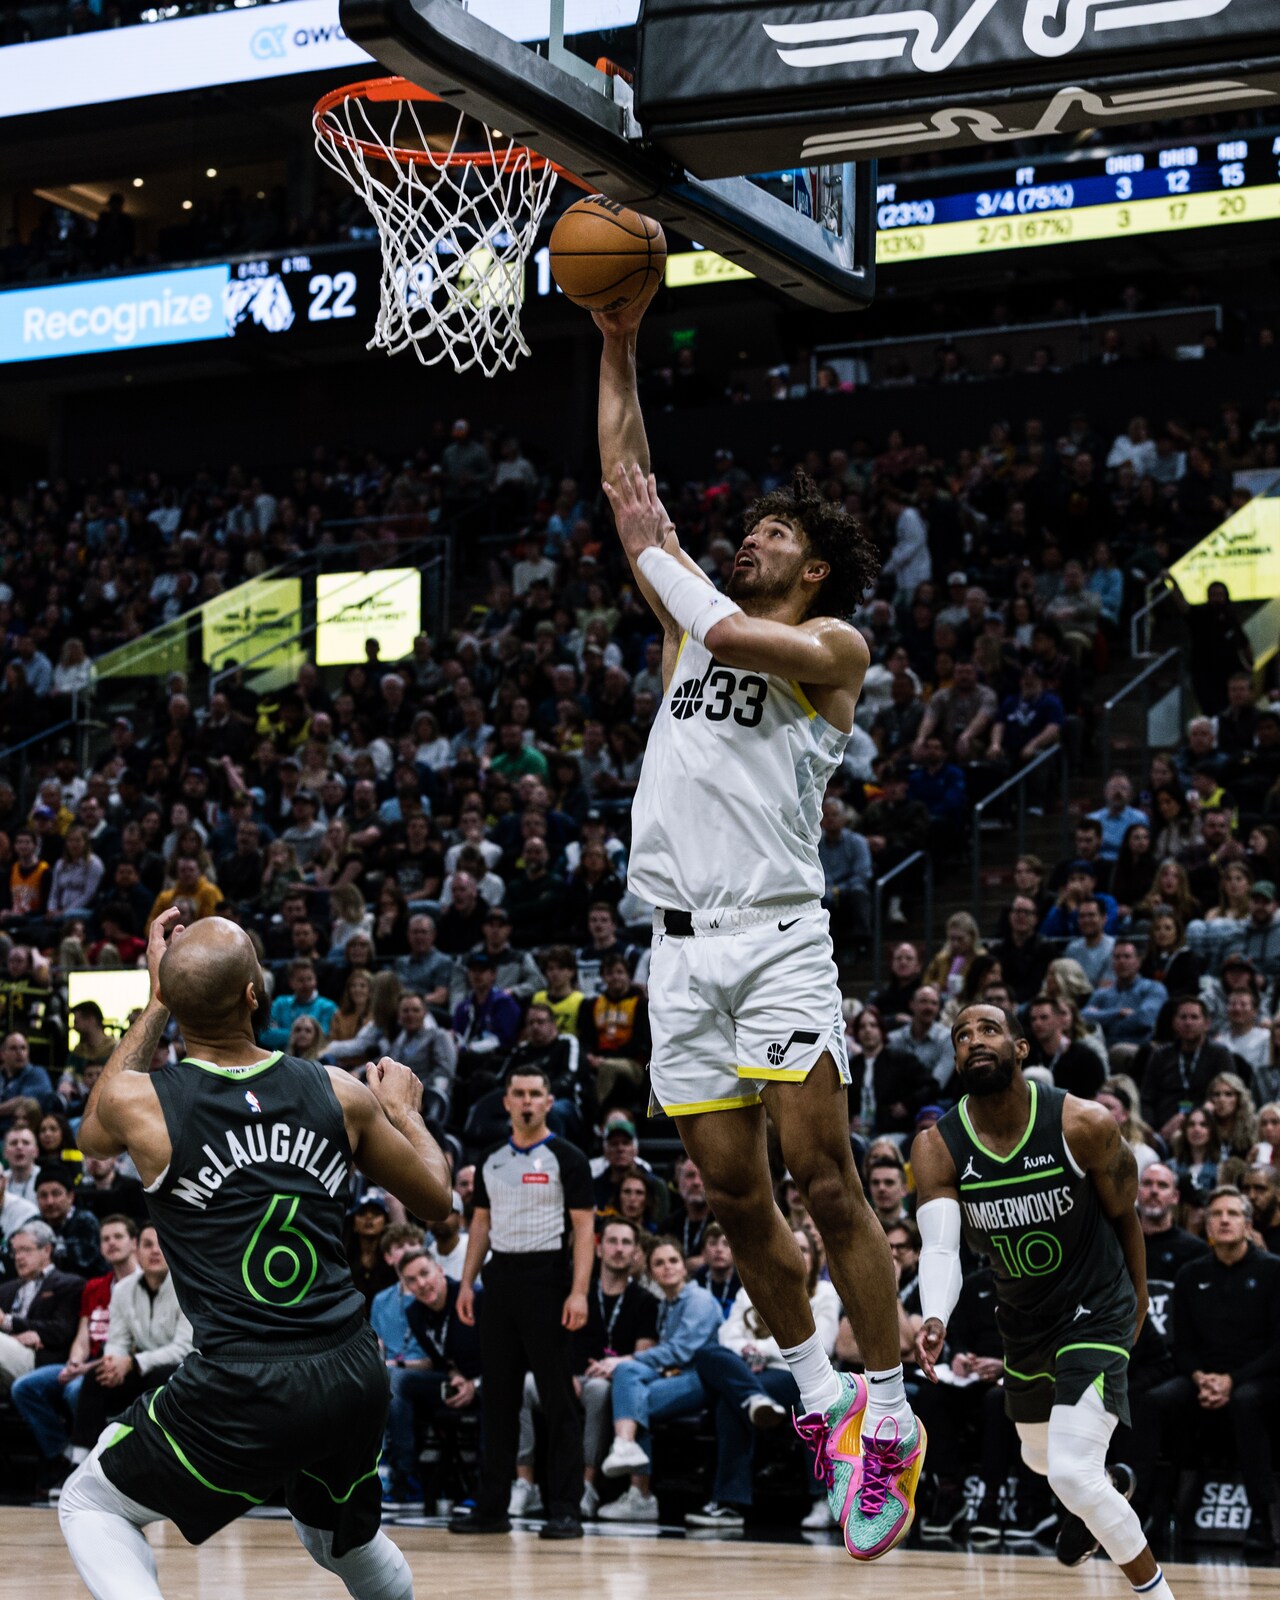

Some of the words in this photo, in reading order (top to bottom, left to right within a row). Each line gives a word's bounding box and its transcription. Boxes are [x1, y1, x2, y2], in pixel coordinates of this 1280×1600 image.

[878, 199, 935, 230] (23%)
[976, 191, 1016, 216] 3/4
[1017, 184, 1075, 214] (75%)
[1115, 176, 1133, 200] 3
[1165, 169, 1191, 193] 12
[1219, 162, 1246, 187] 15
[1016, 167, 1035, 186] FT
[978, 222, 1013, 245] 2/3
[1018, 216, 1074, 245] (67%)
[1117, 209, 1132, 229] 3
[1168, 202, 1189, 223] 17
[1219, 195, 1247, 217] 20
[23, 287, 213, 345] Recognize
[308, 271, 357, 322] 22
[705, 670, 768, 728] 33
[171, 1122, 348, 1211] McLAUGHLIN
[962, 1186, 1074, 1233] TIMBERWOLVES
[242, 1193, 319, 1307] 6
[991, 1231, 1063, 1278] 10
